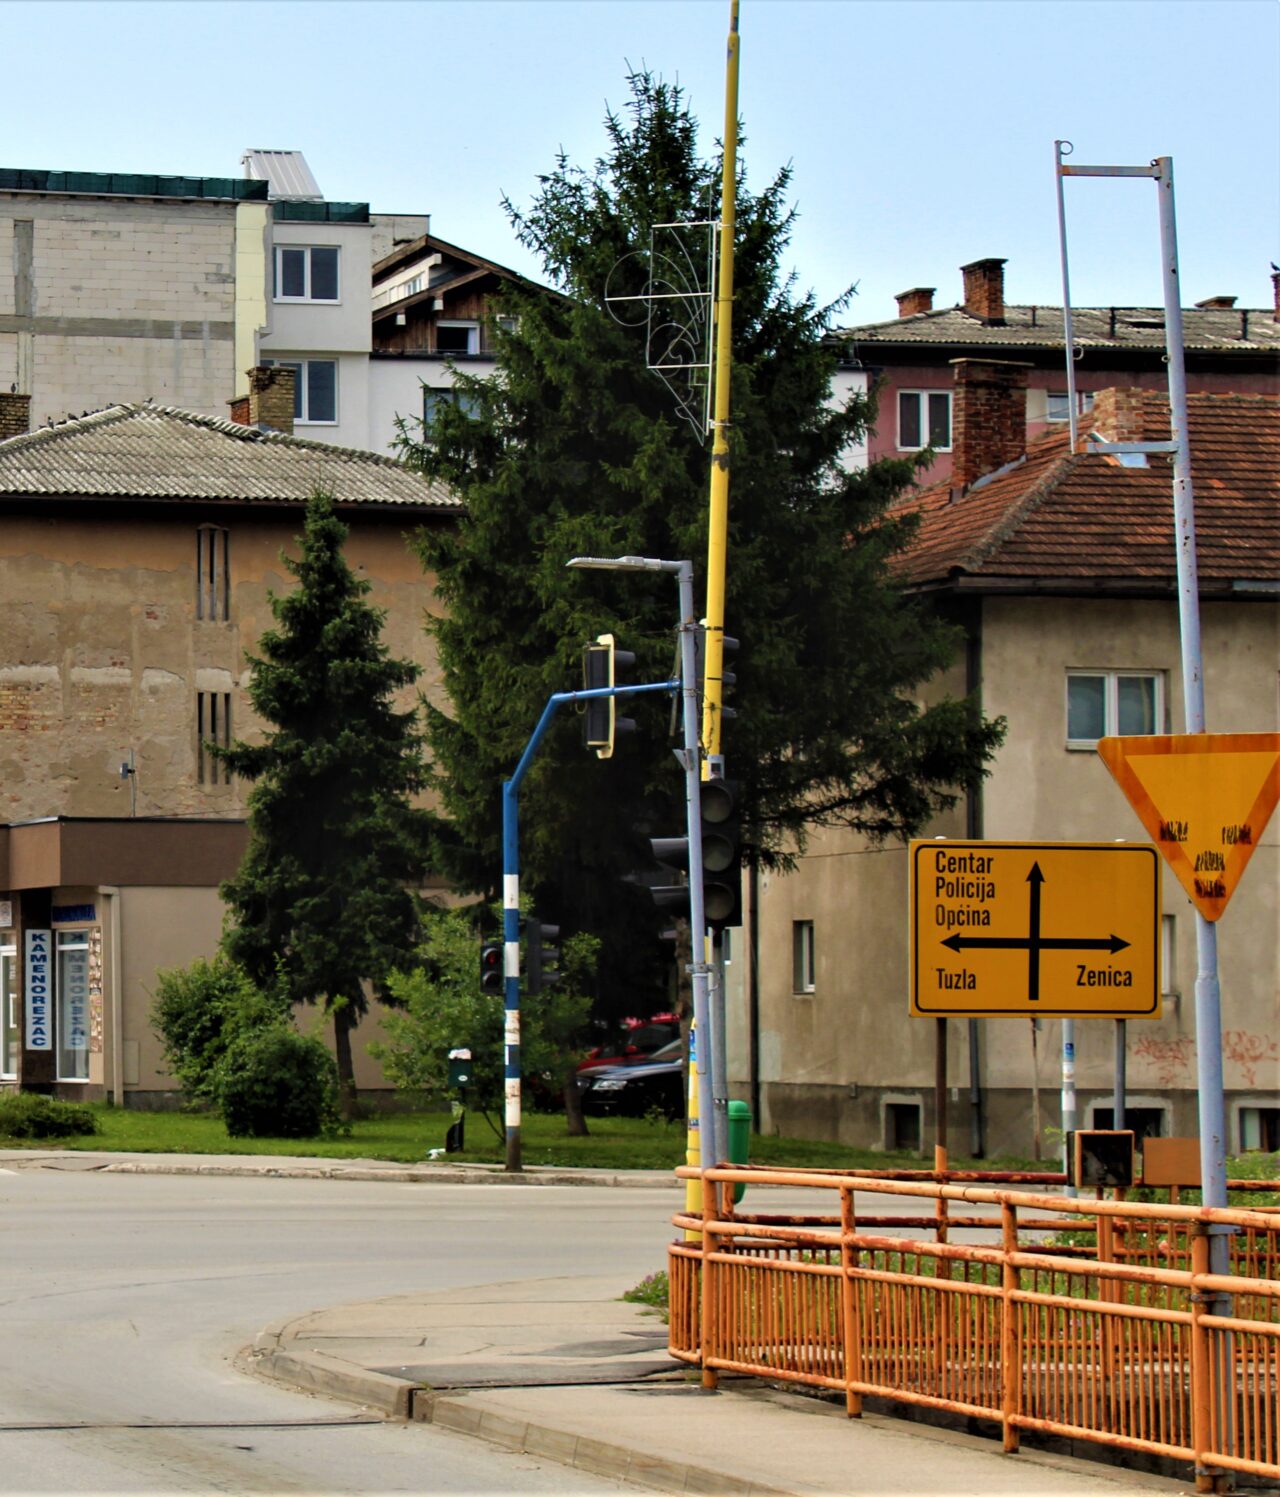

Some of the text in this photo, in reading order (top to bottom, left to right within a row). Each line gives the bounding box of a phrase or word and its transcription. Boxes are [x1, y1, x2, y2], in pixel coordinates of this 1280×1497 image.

[935, 850, 994, 875] Centar
[935, 876, 996, 903] Policija
[935, 903, 991, 930] Općina
[936, 968, 977, 990] Tuzla
[1076, 964, 1133, 987] Zenica
[30, 933, 48, 1046] KAMENOREZAC
